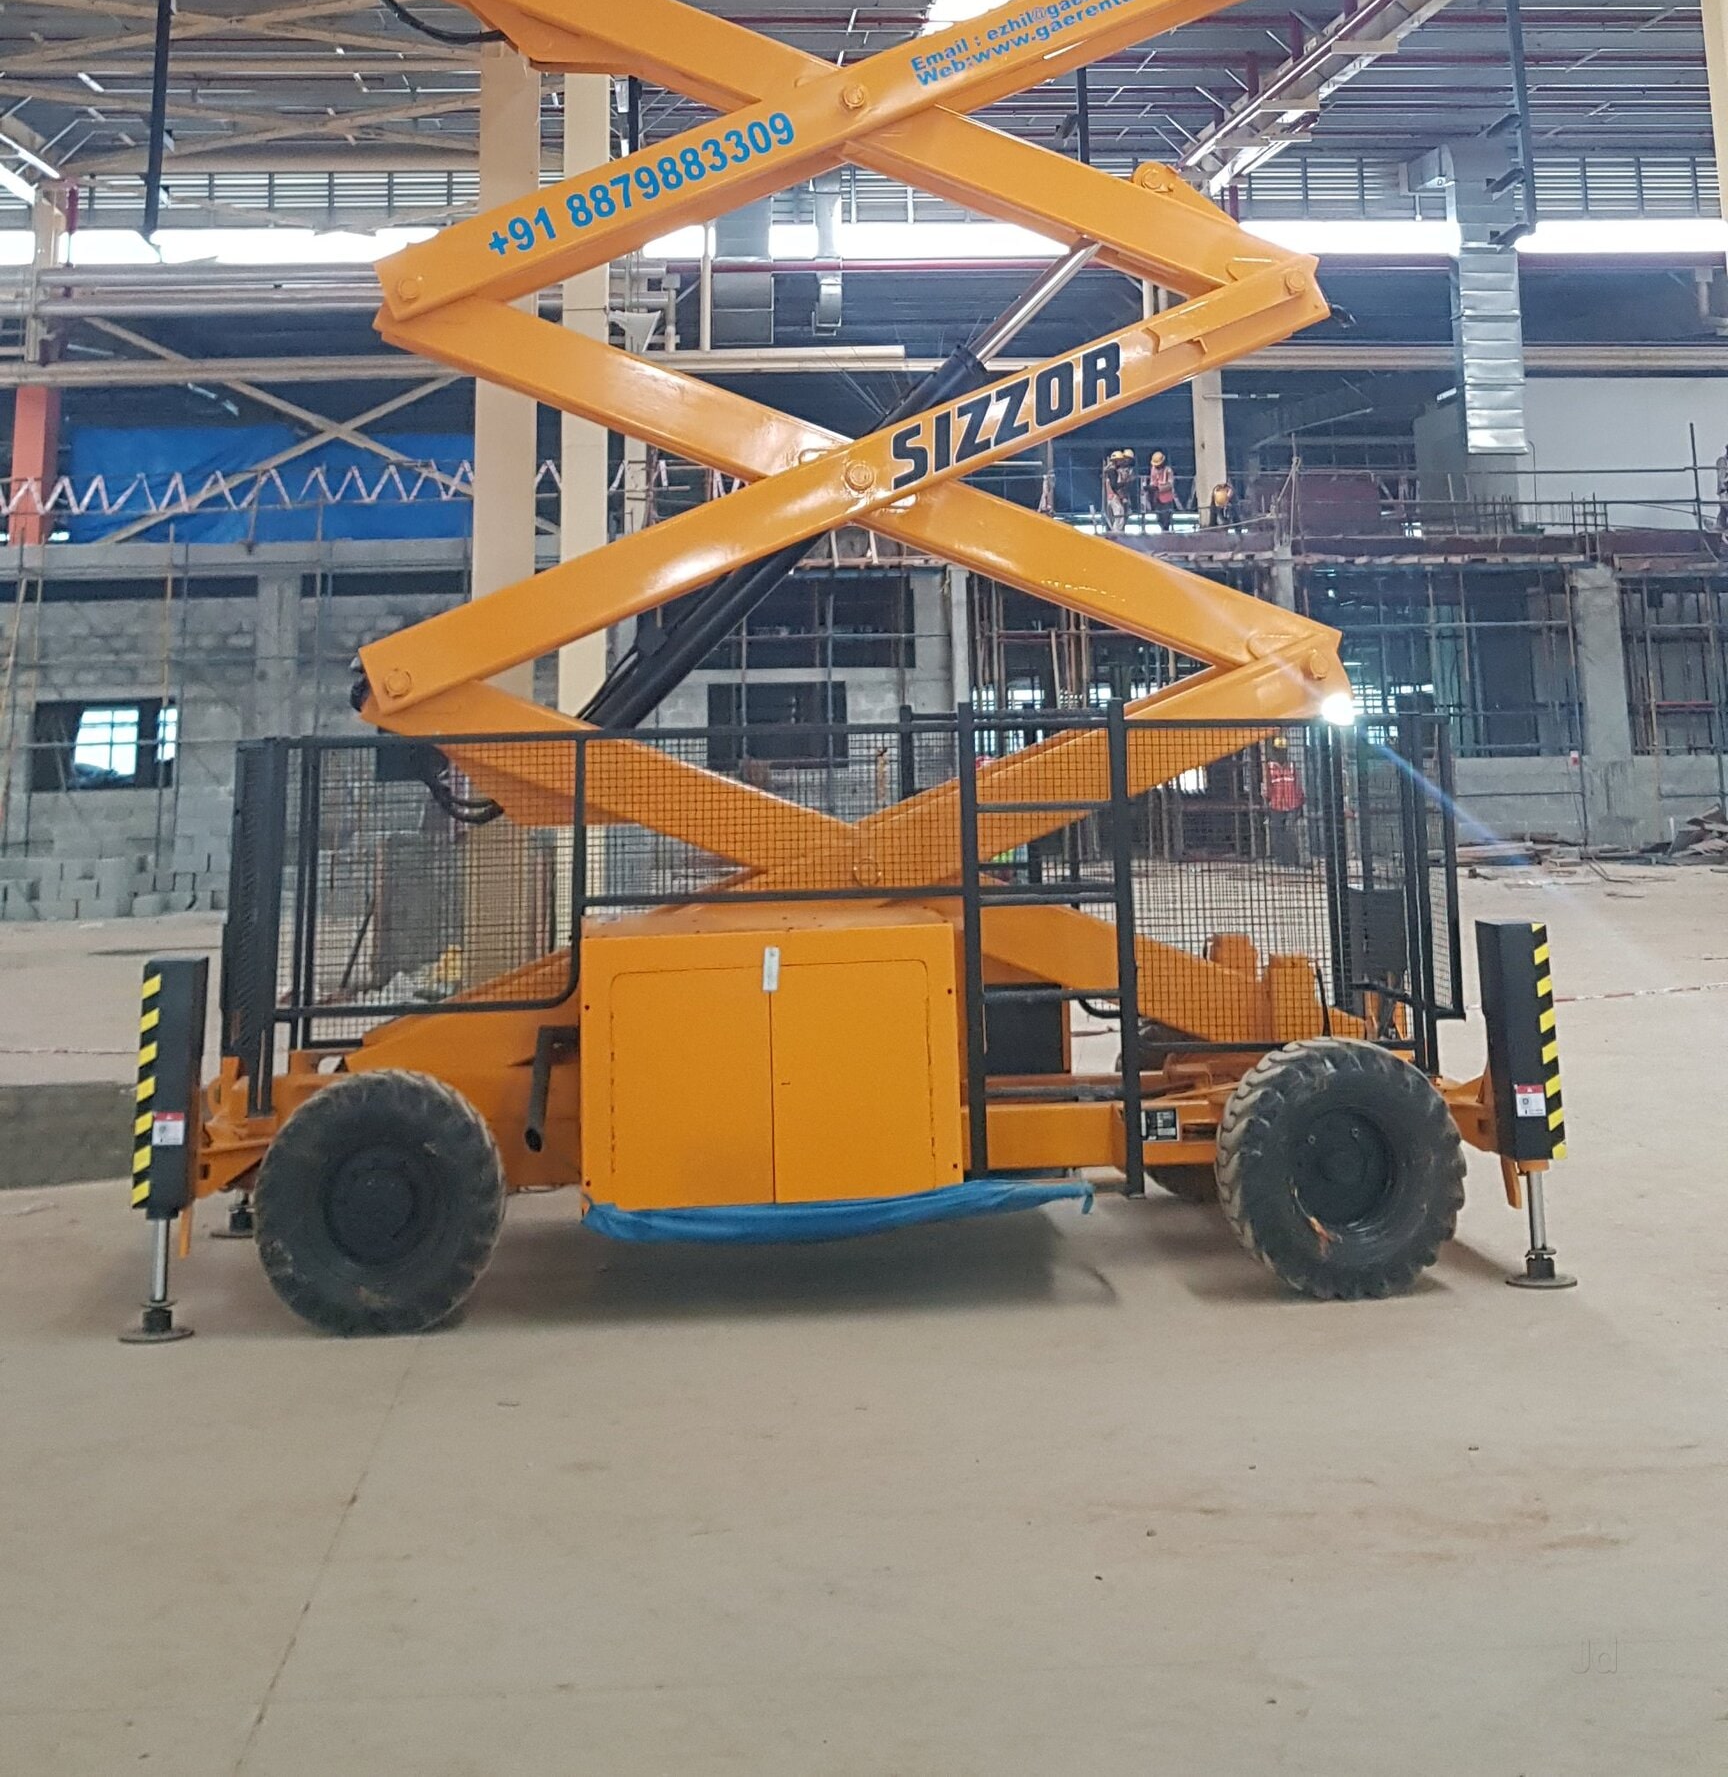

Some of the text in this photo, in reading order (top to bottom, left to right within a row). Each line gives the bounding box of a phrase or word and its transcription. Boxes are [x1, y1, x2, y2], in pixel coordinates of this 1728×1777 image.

[488, 111, 795, 256] +91 8879883309
[891, 340, 1122, 492] SIZZOR
